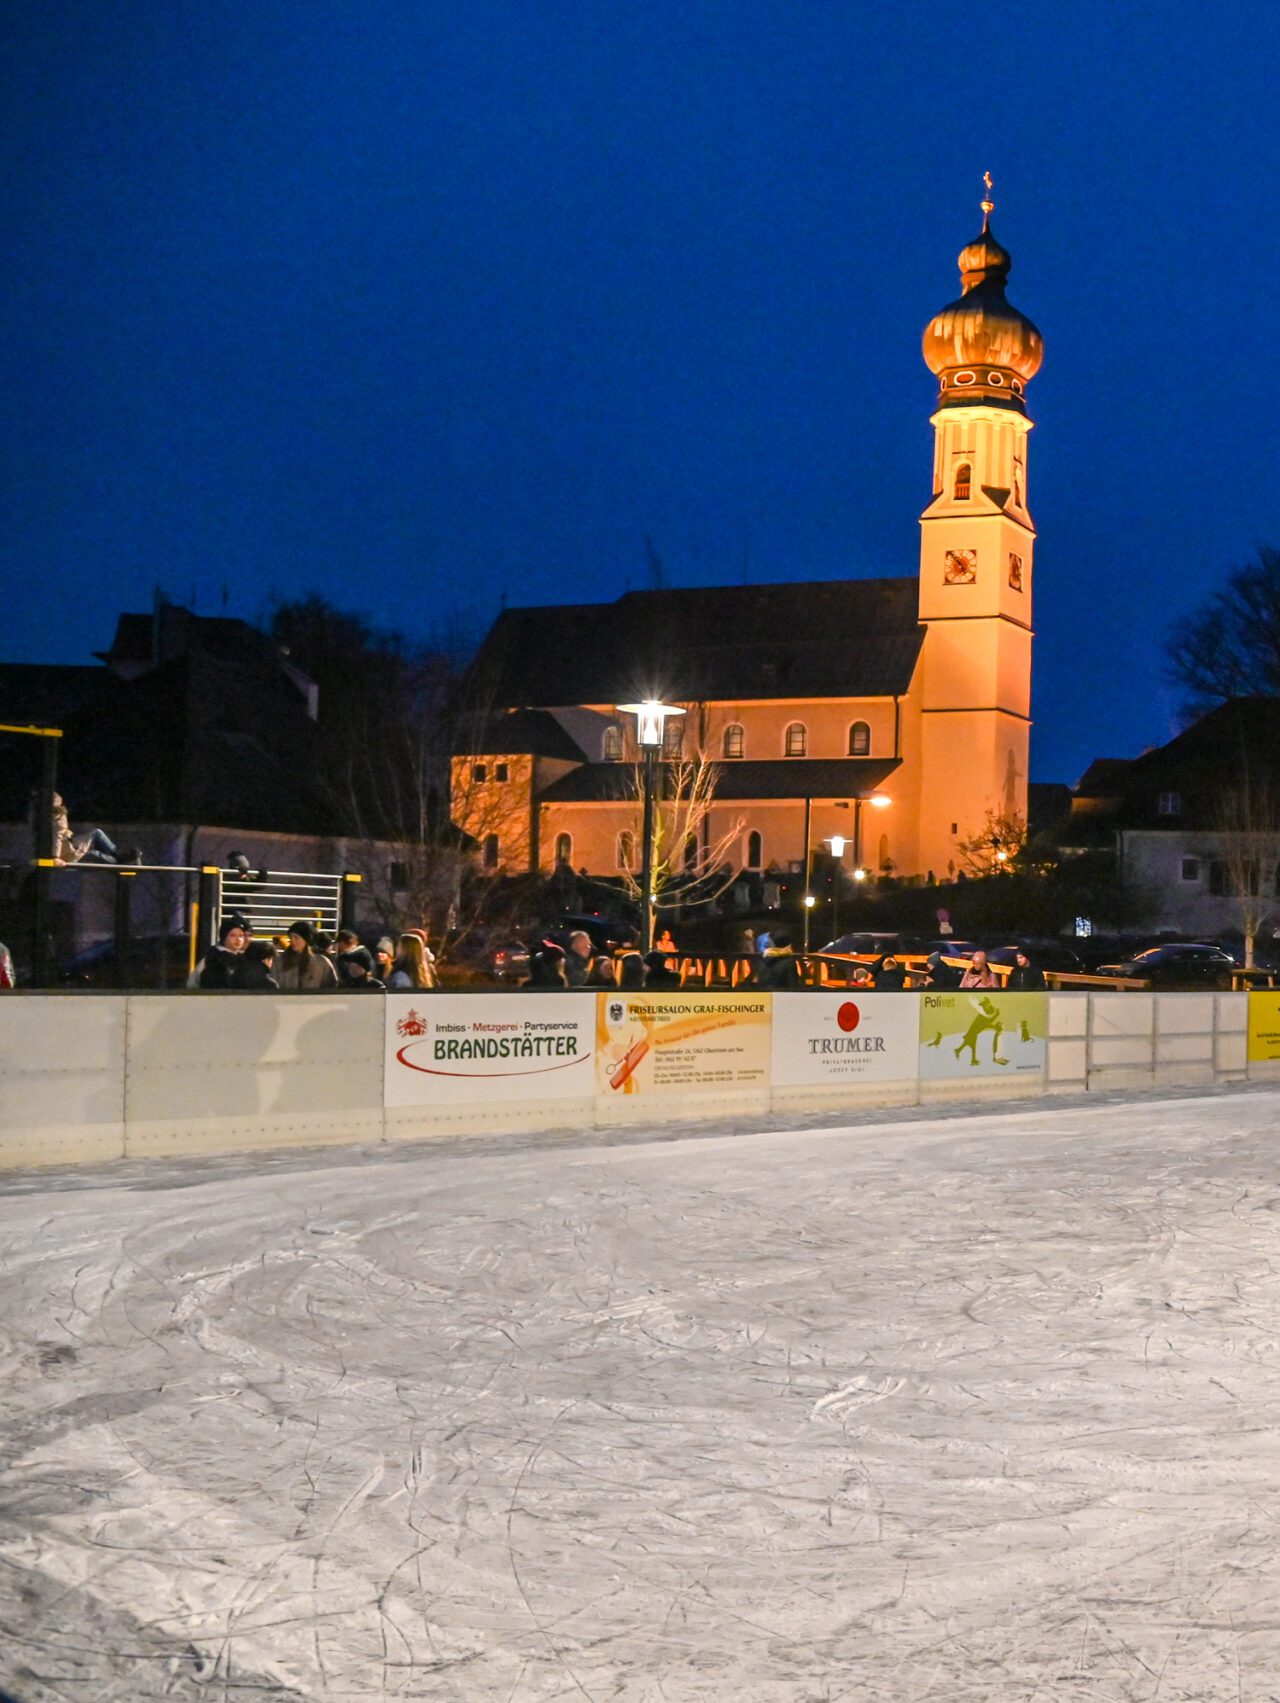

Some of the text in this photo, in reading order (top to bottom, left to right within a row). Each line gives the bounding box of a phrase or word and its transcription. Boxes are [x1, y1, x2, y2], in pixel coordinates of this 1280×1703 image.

[925, 996, 955, 1008] Polivet
[629, 1004, 765, 1014] FRISEURSALON GRAF-FISCHINGER
[435, 1021, 579, 1034] Imbiss Metzgerei Partyservice
[434, 1032, 578, 1060] BRANDSTÄTTER
[808, 1037, 886, 1054] TRUMER
